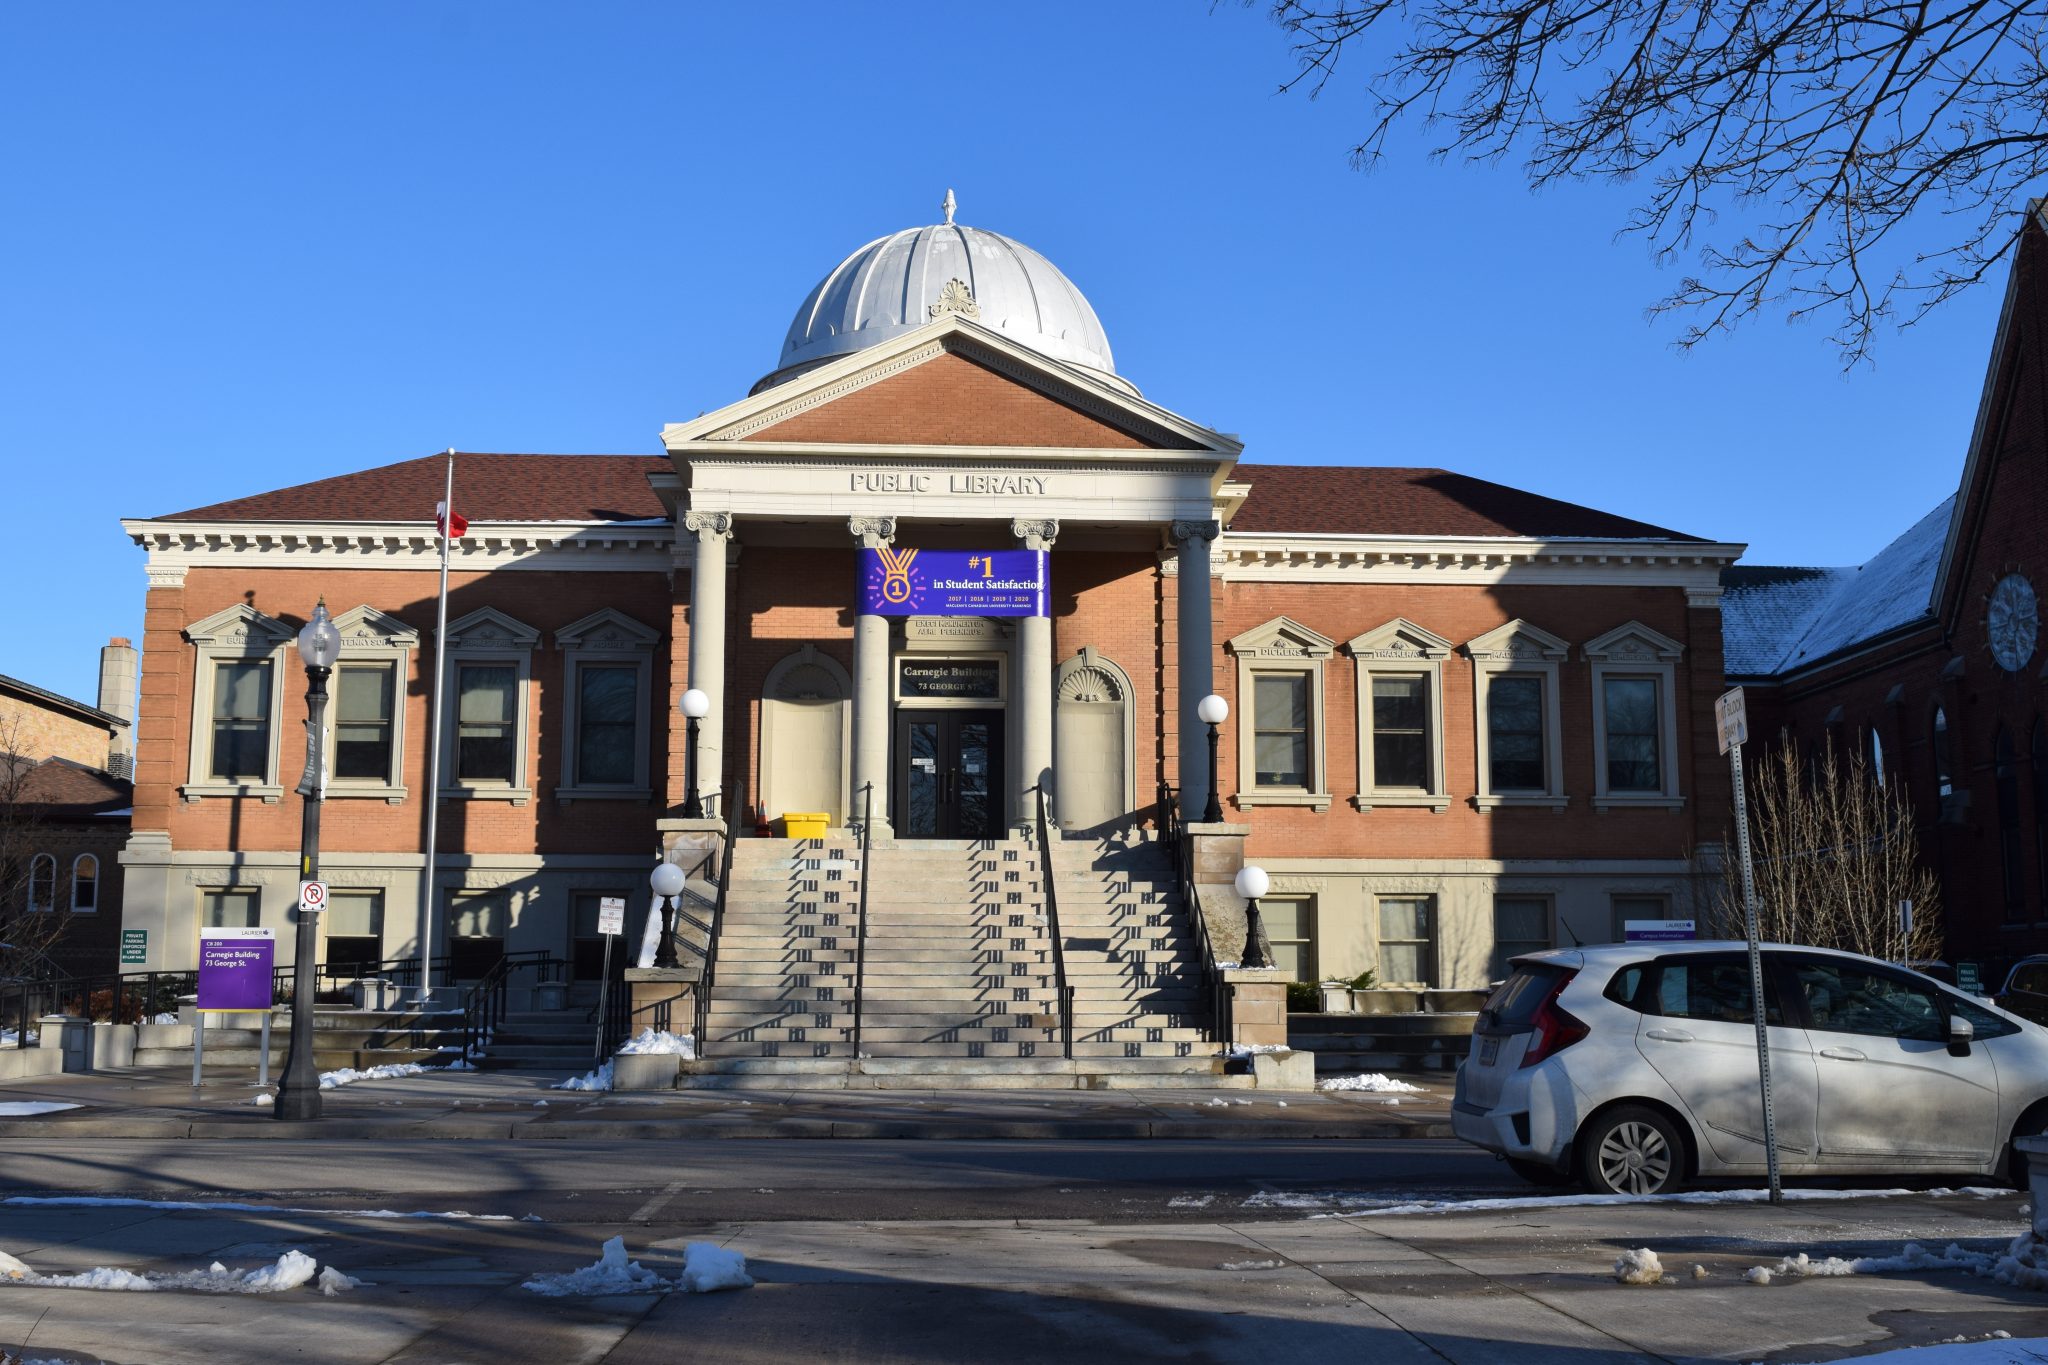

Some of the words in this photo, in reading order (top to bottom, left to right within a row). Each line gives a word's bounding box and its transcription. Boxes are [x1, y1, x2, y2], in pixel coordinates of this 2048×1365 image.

[850, 473, 930, 492] PUBLIC
[950, 474, 1051, 494] LIBRARY
[968, 556, 994, 578] #1
[933, 579, 944, 589] in
[945, 579, 984, 589] Student
[1260, 648, 1302, 657] DICKENS
[904, 666, 949, 678] Carnegie
[951, 667, 995, 679] Building
[205, 951, 234, 960] Carnegie
[234, 951, 260, 960] Building
[214, 960, 237, 969] George
